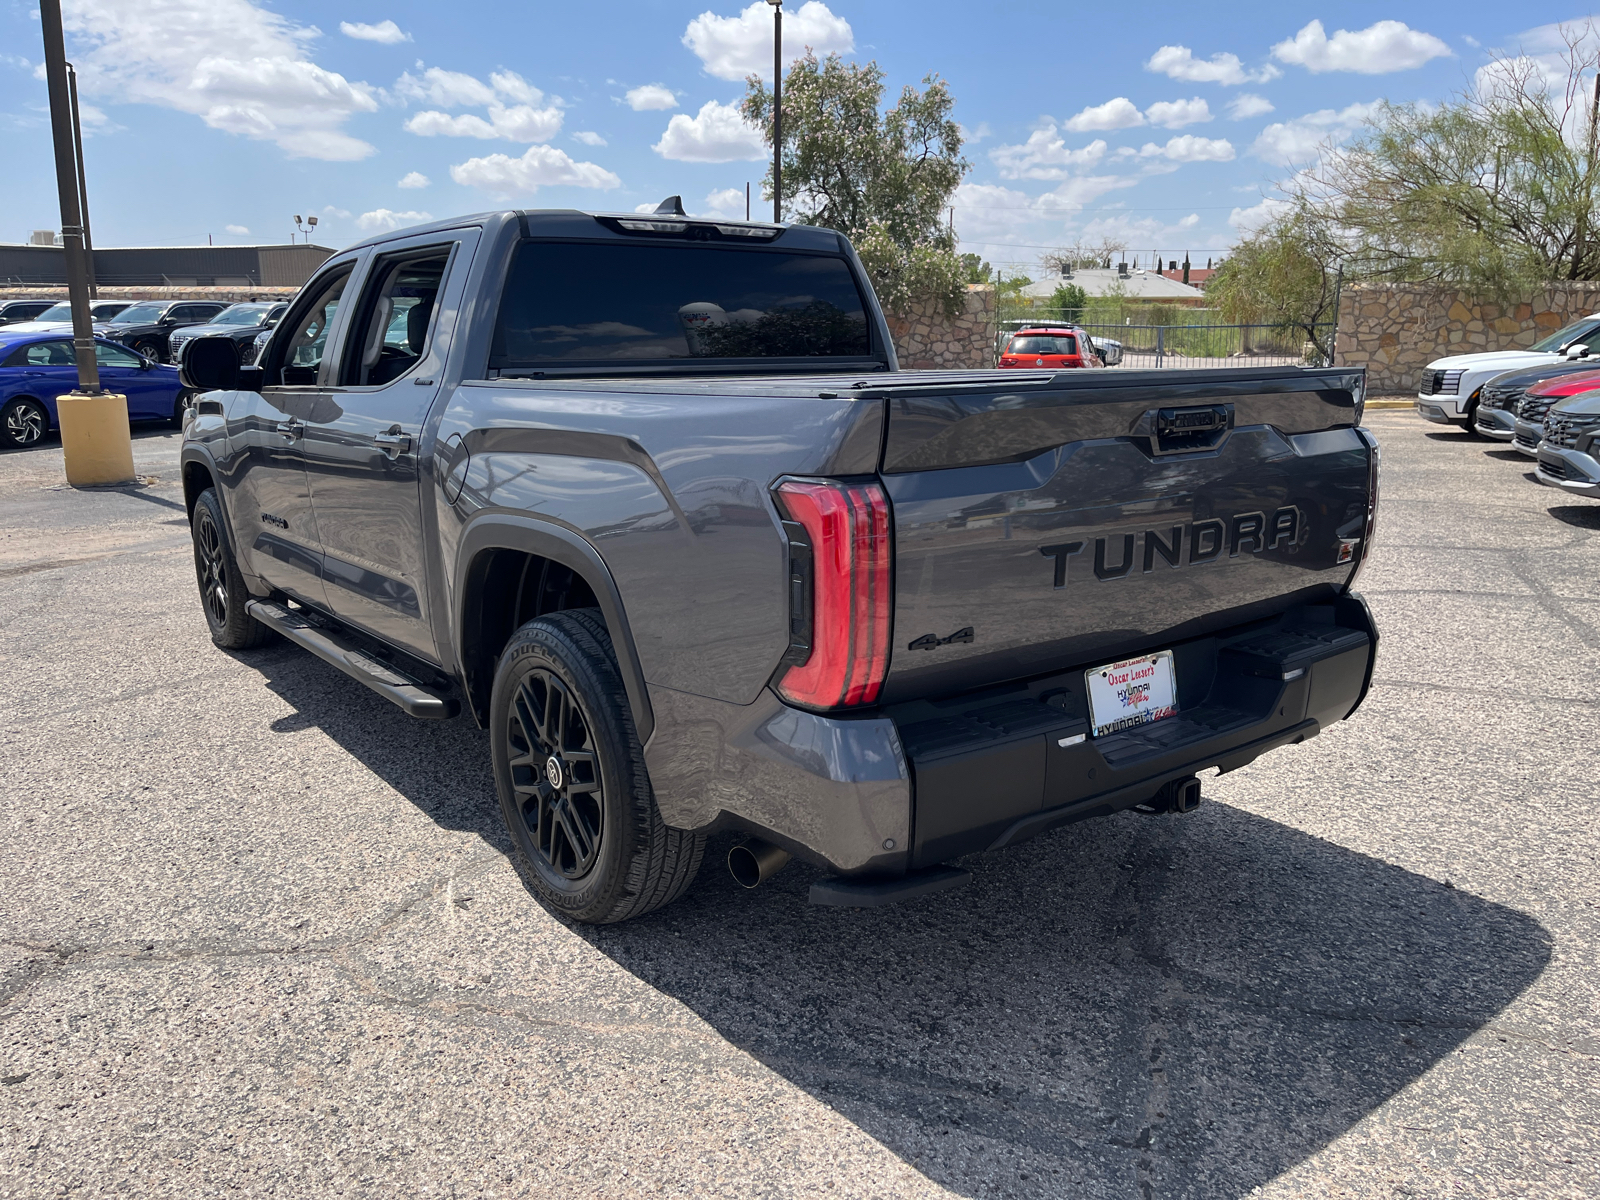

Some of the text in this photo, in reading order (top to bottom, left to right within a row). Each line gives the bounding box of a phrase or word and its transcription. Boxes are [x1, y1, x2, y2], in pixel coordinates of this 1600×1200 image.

[1037, 505, 1300, 590] TUNDRA
[1108, 665, 1155, 686] Oscar Leeser's
[1117, 683, 1150, 698] HYUNDAI
[1098, 715, 1144, 736] HYUNDAI
